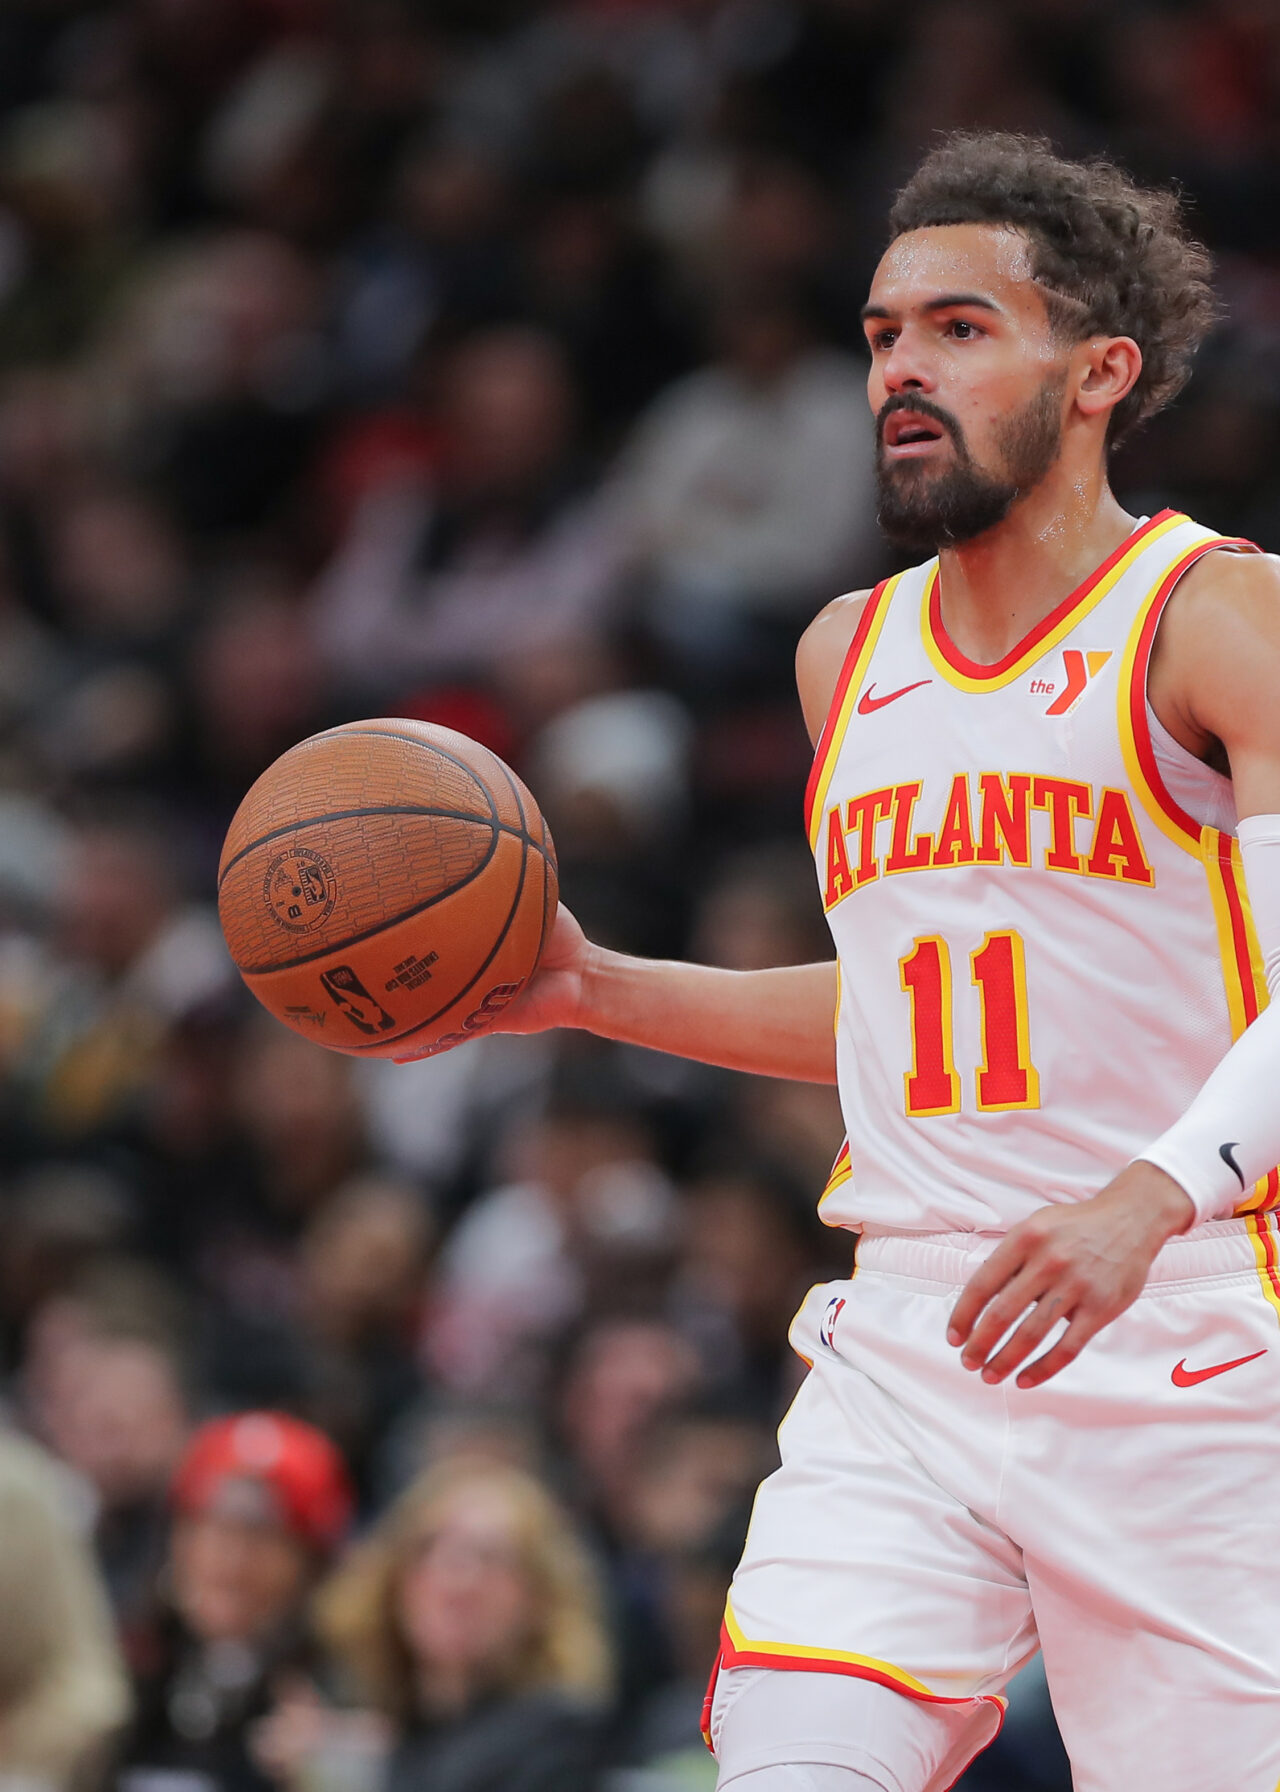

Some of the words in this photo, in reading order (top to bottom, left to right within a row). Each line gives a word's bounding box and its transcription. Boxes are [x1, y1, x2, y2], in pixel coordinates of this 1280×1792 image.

[1029, 679, 1055, 694] the
[823, 771, 1156, 914] ATLANTA
[898, 929, 1041, 1117] 11
